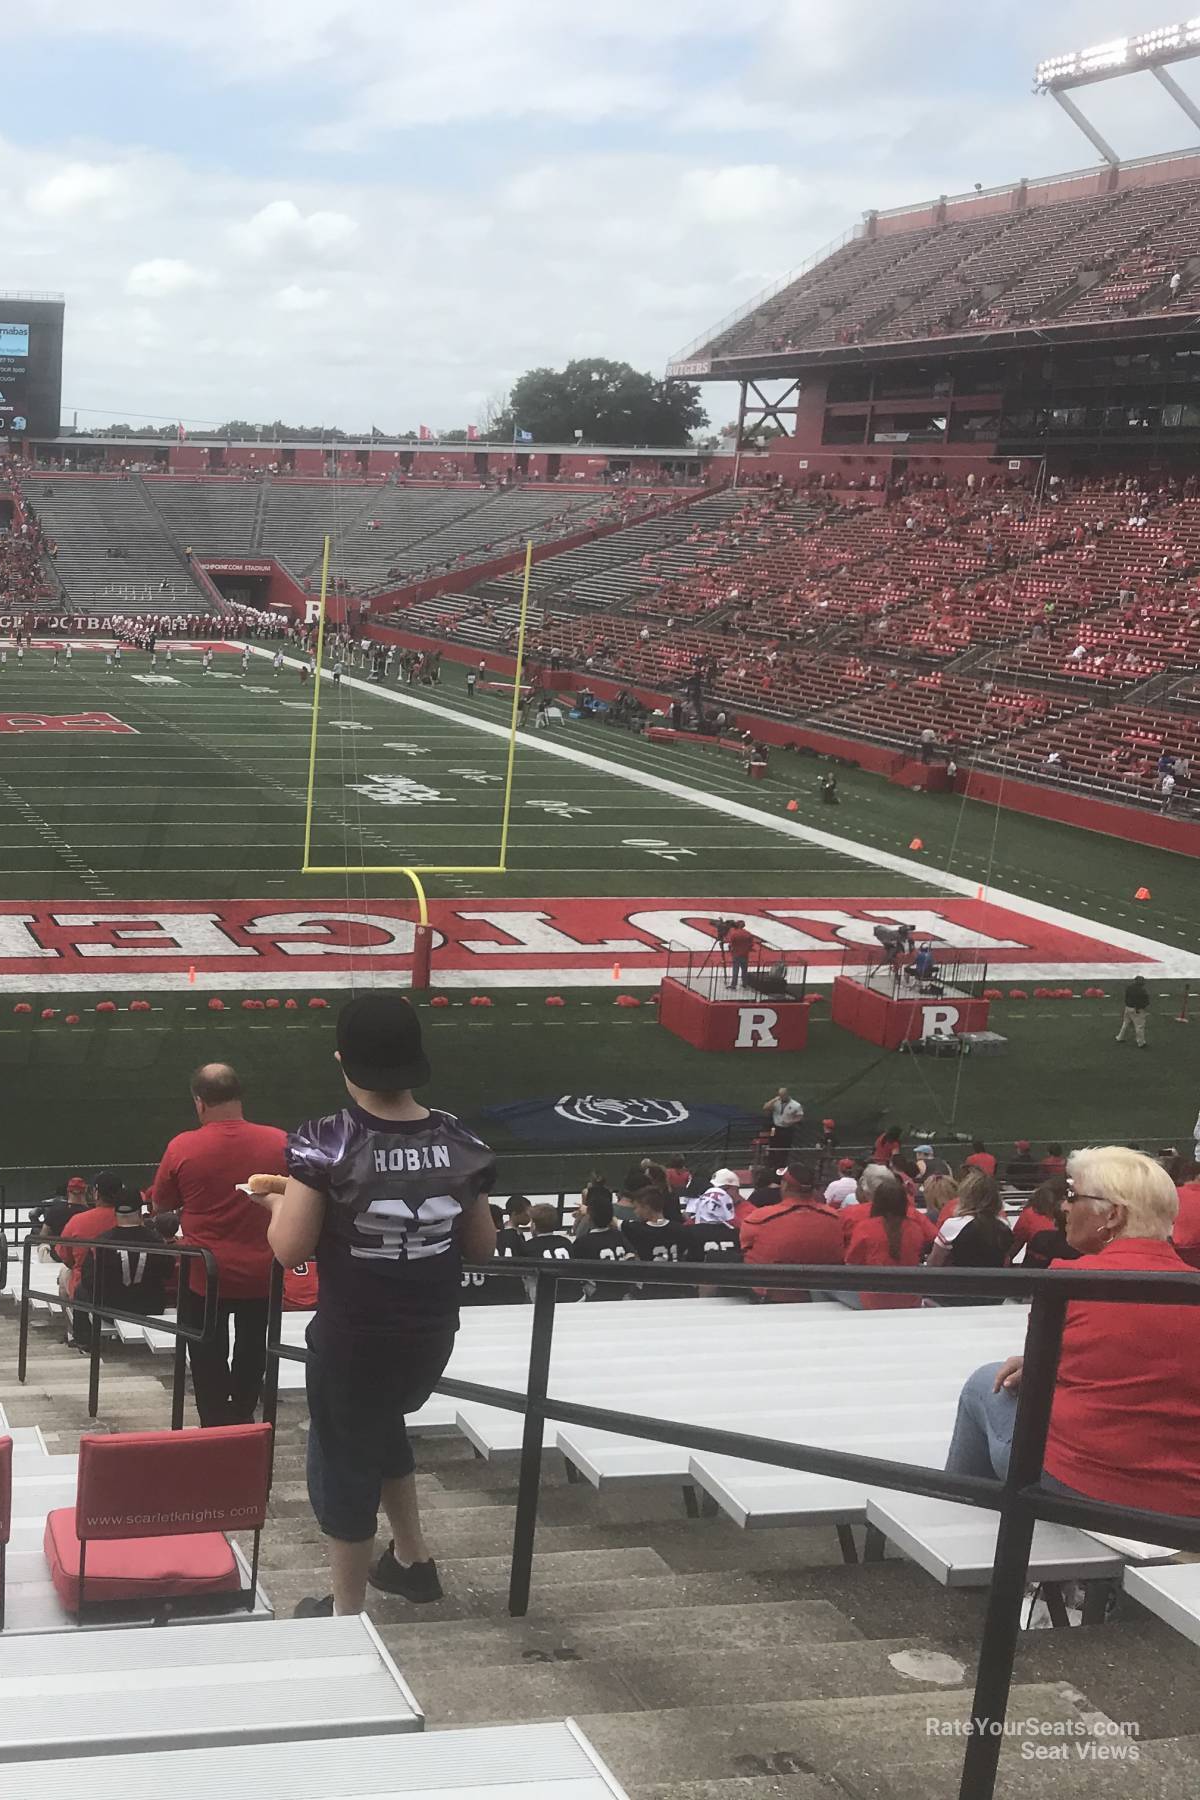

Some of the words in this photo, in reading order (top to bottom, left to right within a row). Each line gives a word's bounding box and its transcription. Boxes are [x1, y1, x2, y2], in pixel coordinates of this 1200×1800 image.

[304, 600, 322, 624] R
[621, 838, 698, 856] 10
[734, 1008, 778, 1048] R
[921, 1005, 960, 1042] R
[373, 1145, 451, 1173] HOBIN
